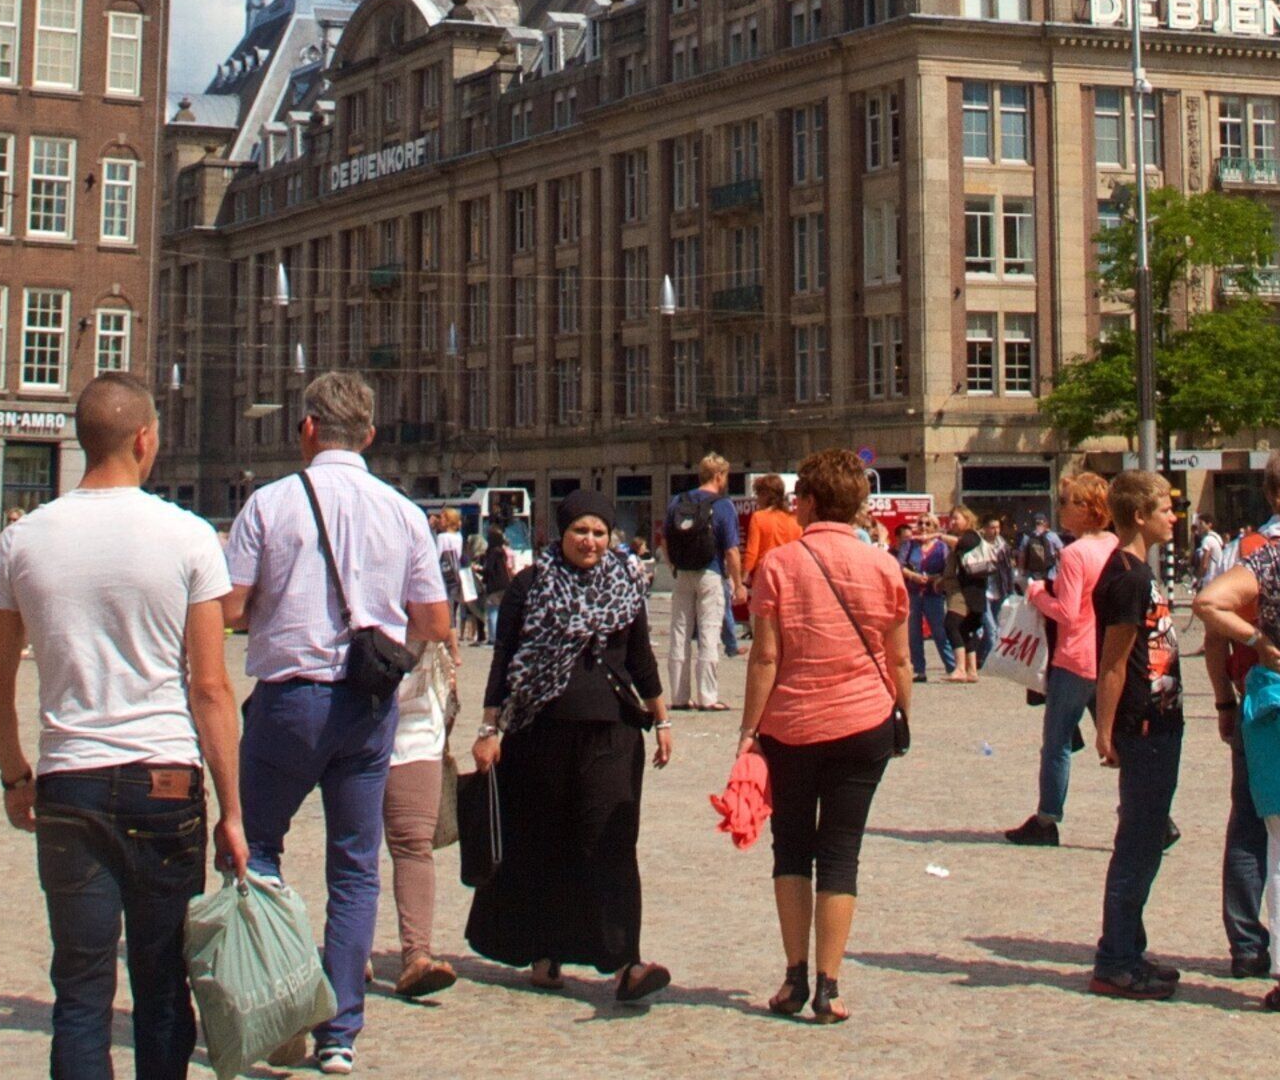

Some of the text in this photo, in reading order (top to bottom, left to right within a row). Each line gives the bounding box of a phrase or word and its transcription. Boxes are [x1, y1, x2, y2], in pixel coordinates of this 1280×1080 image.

[331, 137, 427, 191] DE BIJENKORF
[995, 626, 1040, 667] H&M
